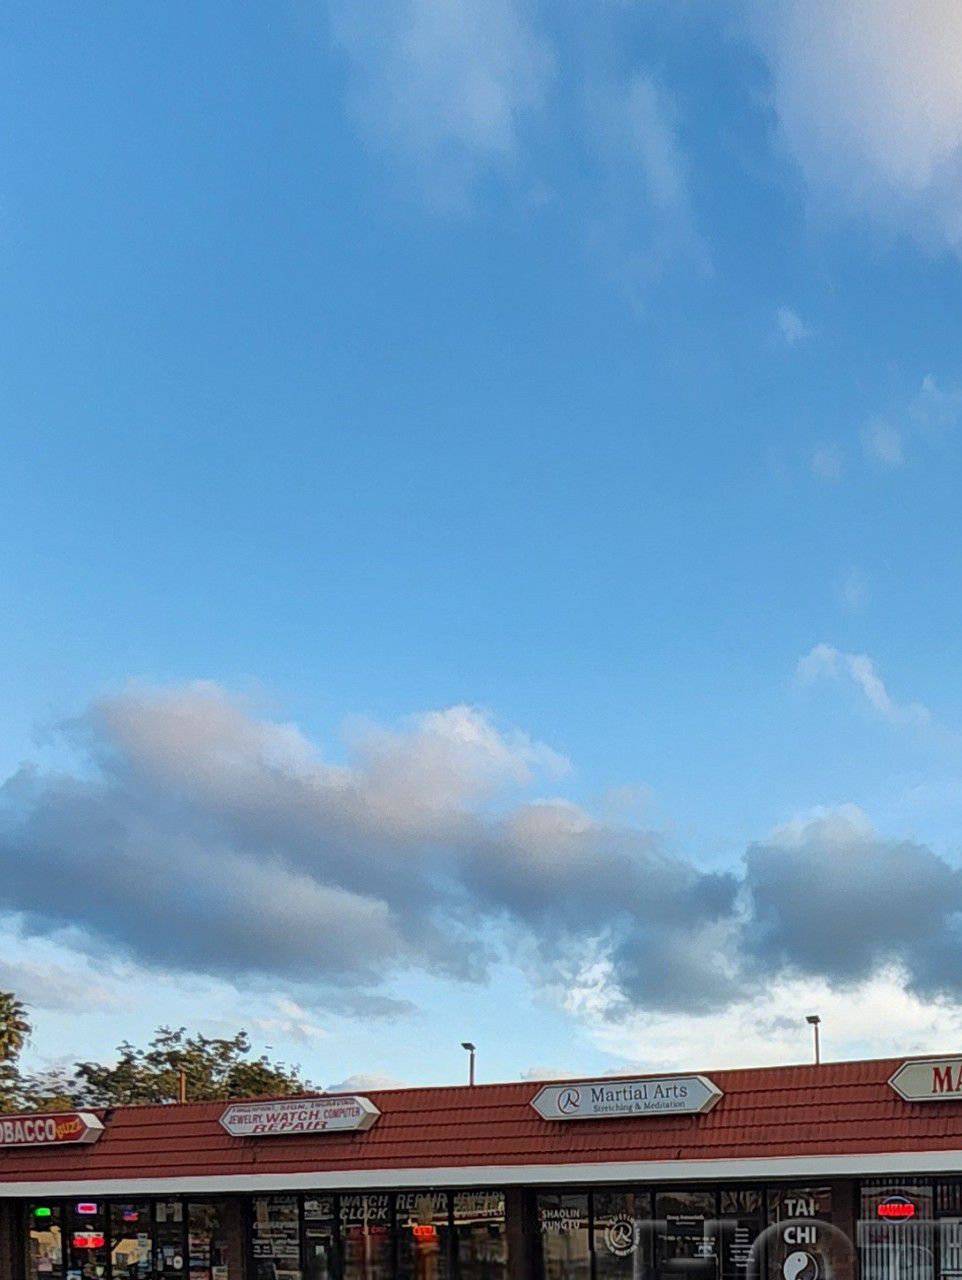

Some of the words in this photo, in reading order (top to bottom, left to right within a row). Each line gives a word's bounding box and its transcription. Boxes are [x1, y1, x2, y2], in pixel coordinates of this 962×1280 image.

[591, 1085, 648, 1103] Martial
[653, 1083, 688, 1099] Arts
[323, 1106, 361, 1119] COMPUTER
[593, 1104, 632, 1113] Stretching
[634, 1103, 642, 1111] &
[643, 1100, 686, 1110] Meditation
[0, 1118, 56, 1143] BACCO
[252, 1121, 328, 1133] REPAIR
[340, 1195, 389, 1207] WATCH
[340, 1207, 388, 1220] CLOCK
[541, 1208, 580, 1219] SHAOLIN
[783, 1199, 815, 1217] TAI
[783, 1226, 816, 1244] CHI
